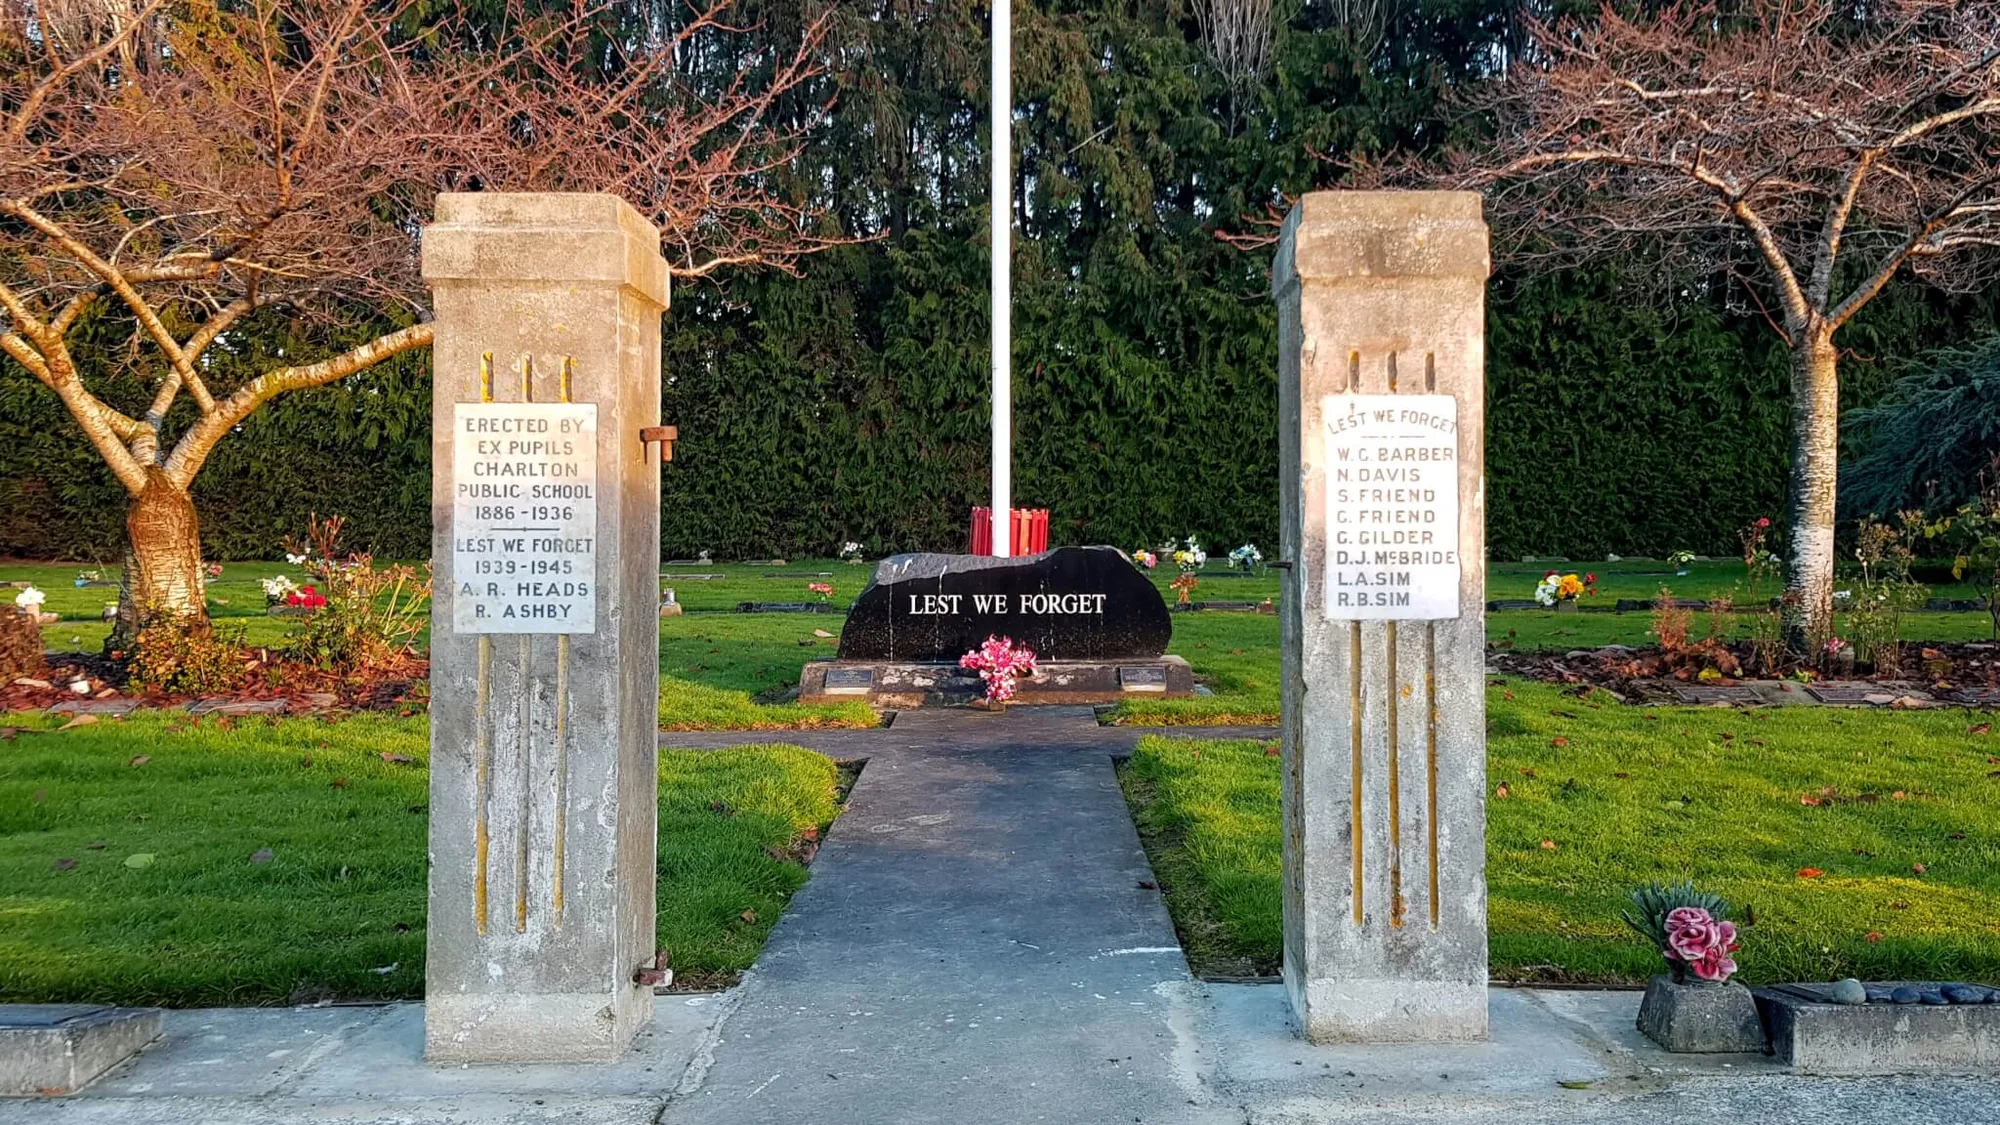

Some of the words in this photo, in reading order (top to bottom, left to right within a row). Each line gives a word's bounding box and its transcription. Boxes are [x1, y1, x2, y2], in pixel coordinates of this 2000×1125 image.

[466, 418, 548, 433] ERECTED
[560, 418, 585, 433] BY
[1328, 412, 1366, 435] LEST
[1373, 409, 1395, 423] WE
[1400, 410, 1456, 435] FORGET
[478, 440, 502, 455] EX
[509, 440, 573, 456] PUPILS
[1378, 447, 1454, 462] BARBER
[473, 462, 578, 477] CHARLTON
[1337, 468, 1354, 482] N.
[1359, 468, 1420, 482] DAVIS
[458, 483, 520, 498] PUBLIC
[532, 484, 593, 499] SCHOOL
[1337, 489, 1354, 503] S.
[1359, 489, 1435, 503] FRIEND
[1359, 510, 1435, 524] FRIEND
[1358, 530, 1434, 545] GILDER
[456, 538, 496, 553] LEST
[502, 538, 525, 553] WE
[532, 538, 593, 554] FORGET
[517, 582, 589, 597] HEADS
[475, 604, 492, 619] R.
[502, 603, 573, 619] ASHBY
[909, 594, 962, 615] LEST
[972, 594, 1008, 615] WE
[1019, 594, 1107, 616] FORGET
